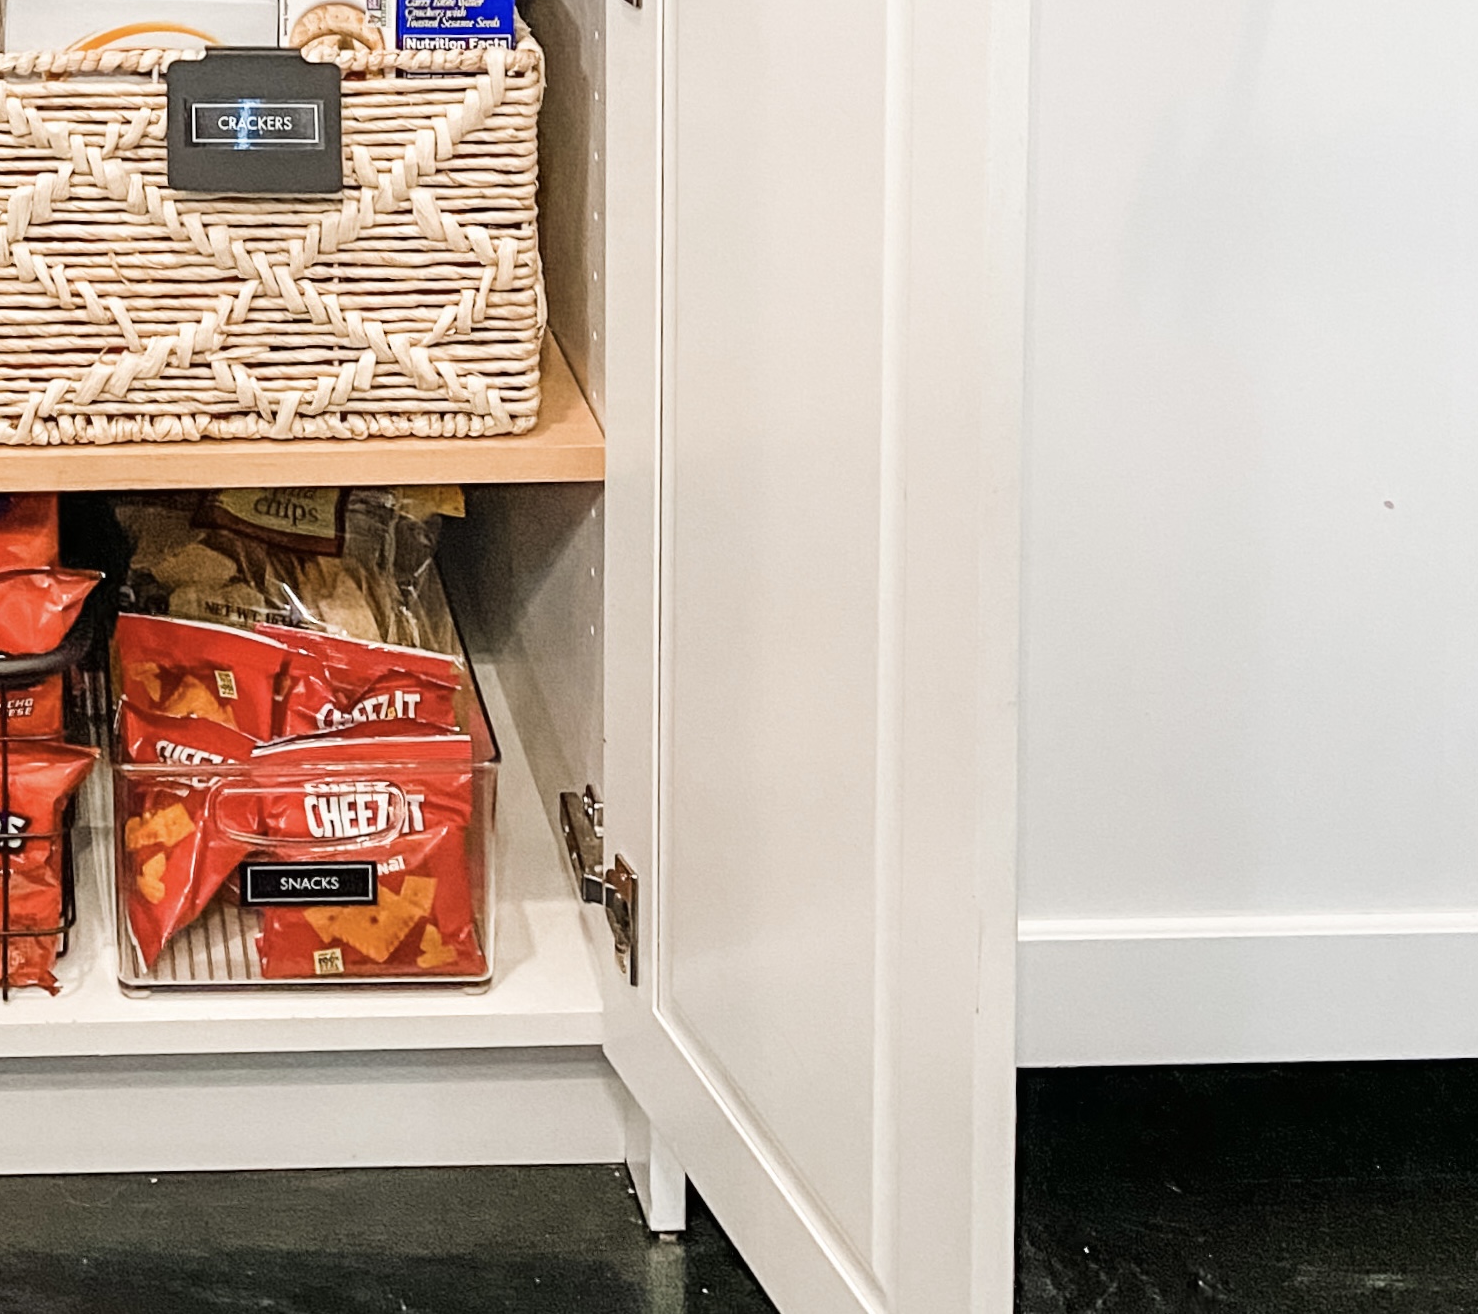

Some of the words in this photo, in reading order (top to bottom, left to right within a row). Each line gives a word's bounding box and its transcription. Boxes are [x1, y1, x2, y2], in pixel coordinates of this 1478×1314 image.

[404, 7, 445, 19] Crackers
[445, 6, 467, 18] with
[405, 17, 440, 29] Toasted
[440, 17, 475, 29] Sesame
[475, 16, 501, 28] Seeds
[405, 36, 466, 50] Nutrition
[468, 37, 508, 50] Facts
[217, 115, 293, 132] CRACKERS
[205, 601, 230, 617] NET
[279, 876, 340, 891] SNACKS
